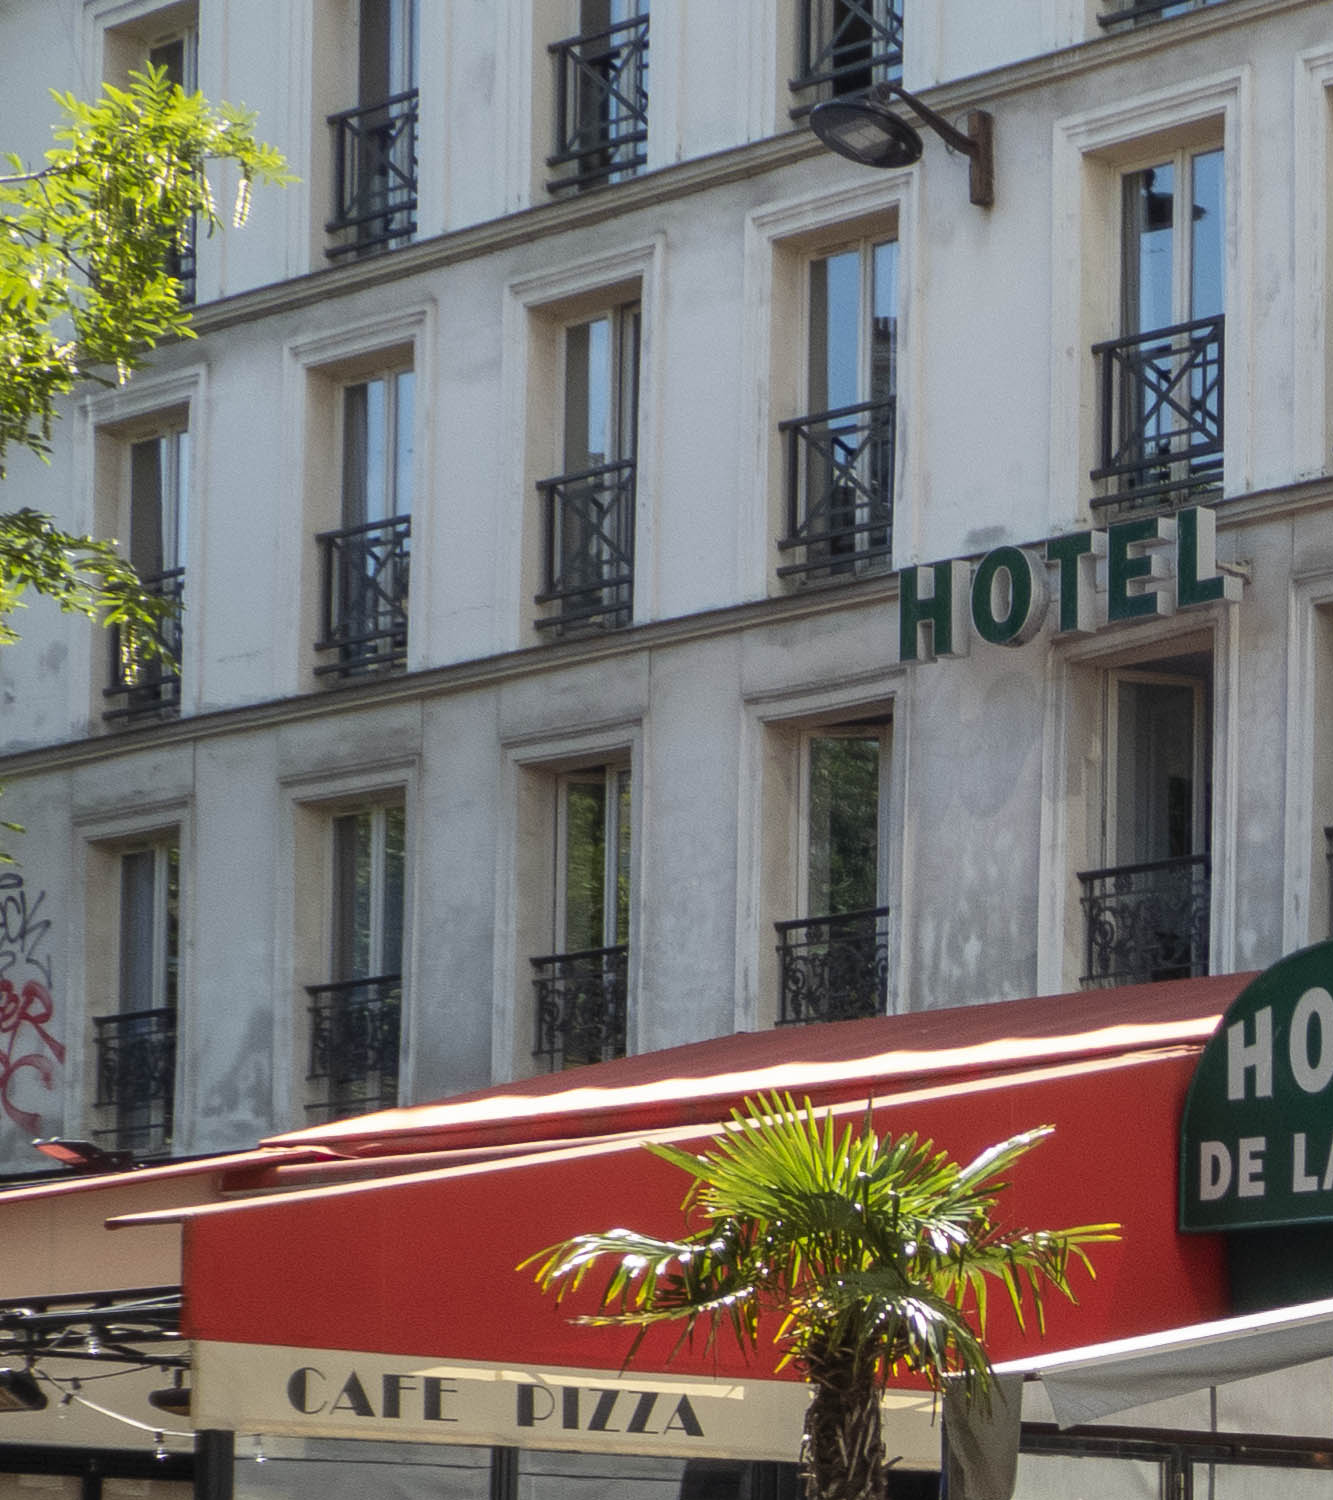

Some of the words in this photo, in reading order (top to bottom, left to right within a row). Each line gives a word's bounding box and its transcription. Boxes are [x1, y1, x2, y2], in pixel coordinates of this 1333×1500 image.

[898, 506, 1238, 661] HOTEL
[1200, 1136, 1266, 1201] DE
[287, 1366, 459, 1422] CAFE
[516, 1383, 705, 1438] PIZZA
